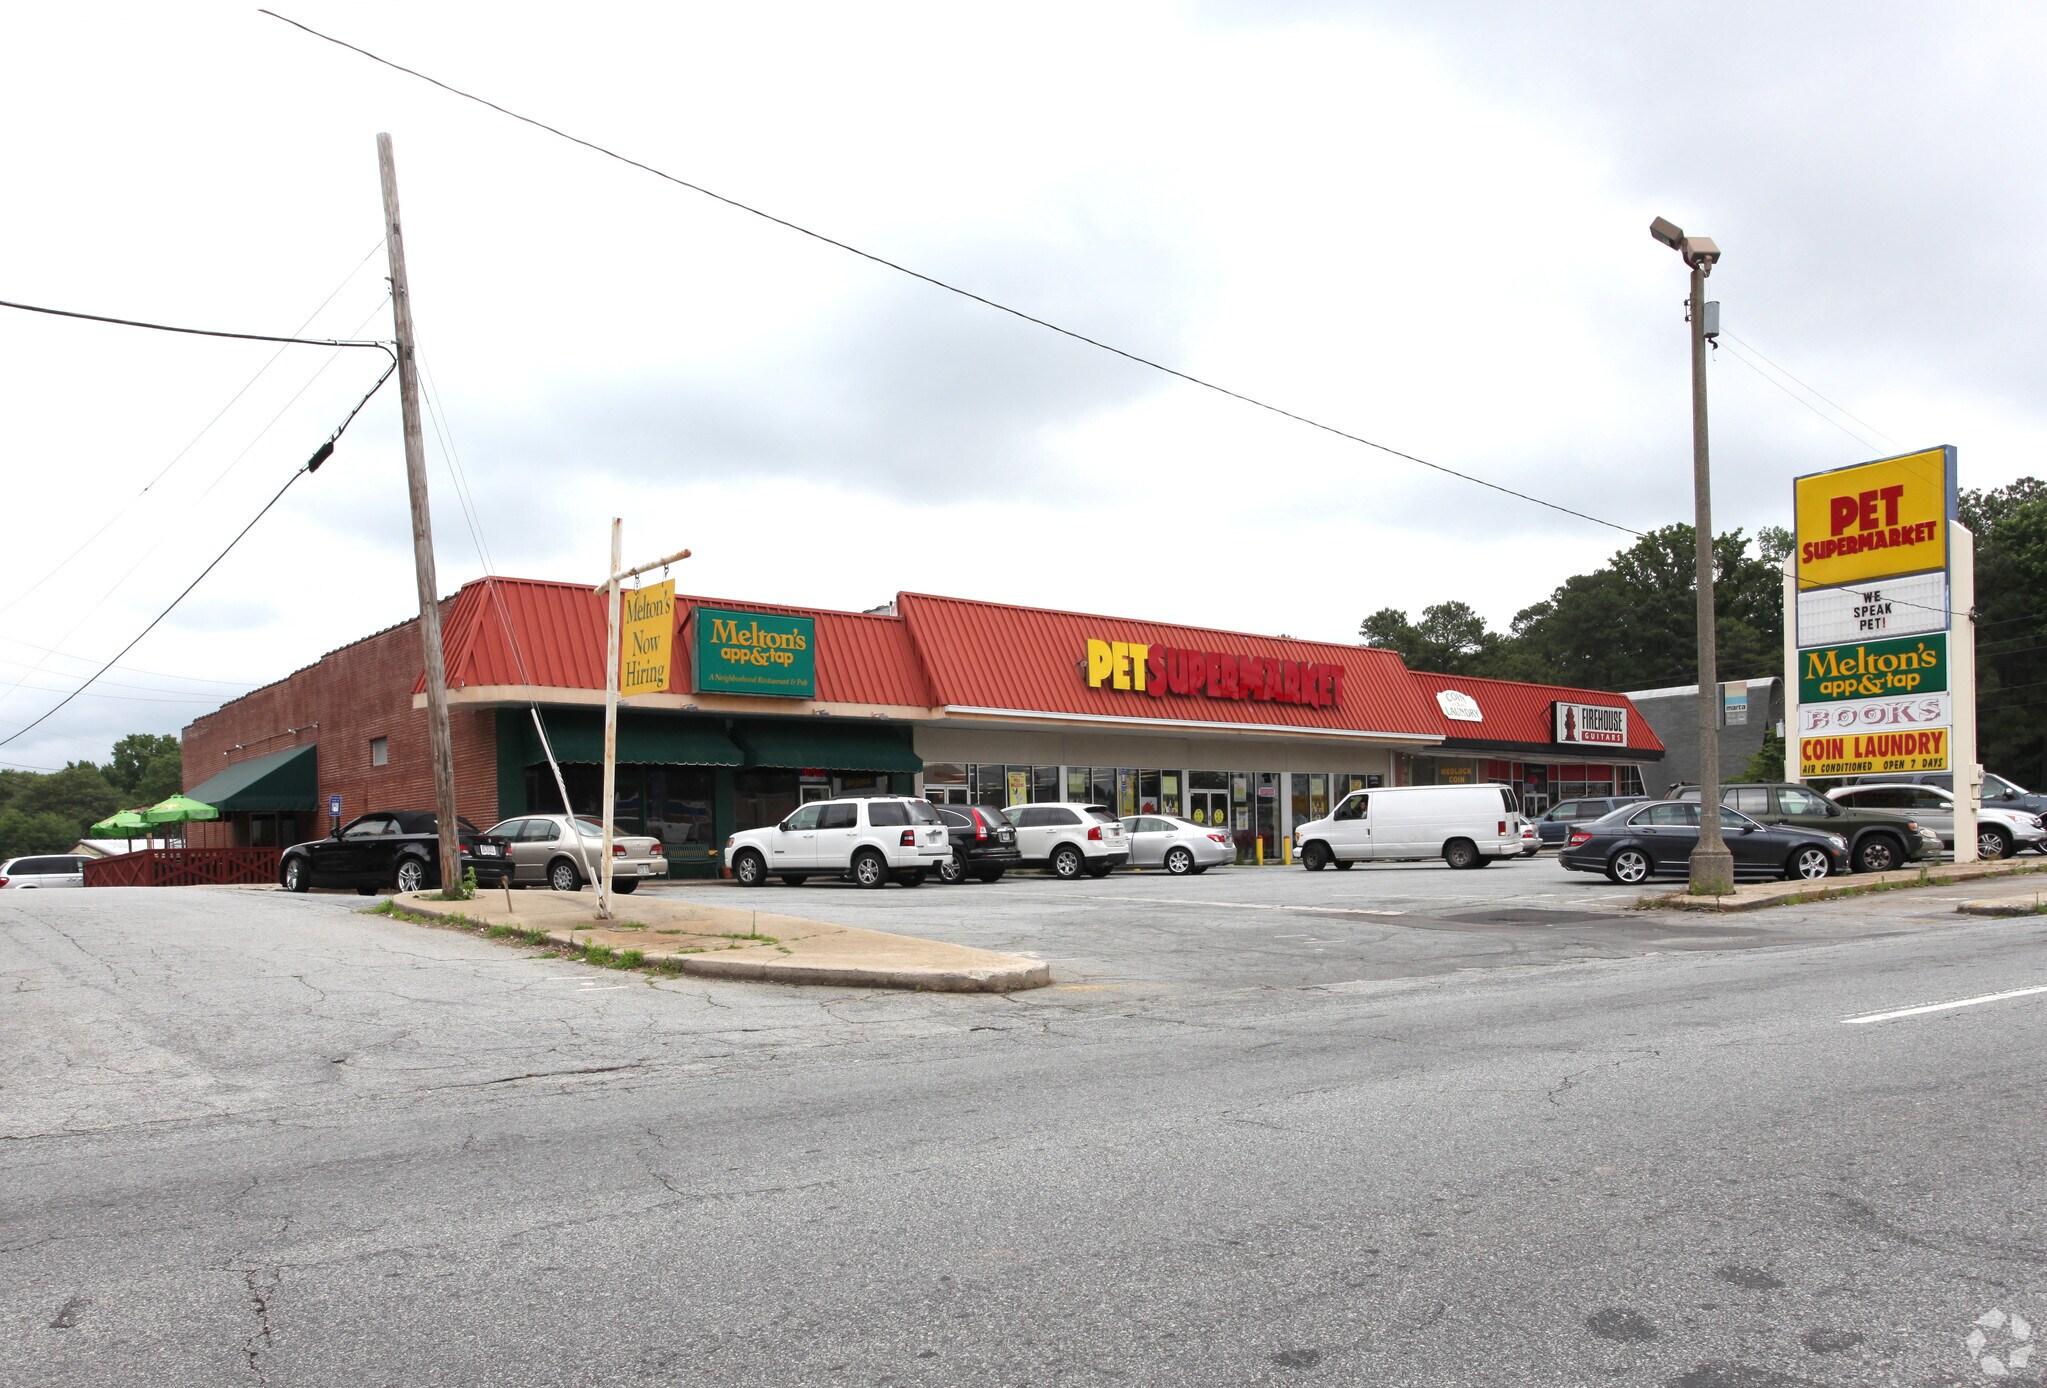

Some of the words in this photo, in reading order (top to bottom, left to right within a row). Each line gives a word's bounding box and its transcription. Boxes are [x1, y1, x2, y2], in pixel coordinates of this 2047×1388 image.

[1830, 484, 1904, 537] PET
[1802, 520, 1937, 565] SUPERMARKET
[626, 590, 671, 625] Melton's
[1853, 602, 1892, 618] SPEAK
[1863, 590, 1881, 604] WE
[709, 618, 807, 651] Melton's
[1859, 617, 1886, 631] PET!
[632, 629, 661, 657] Now
[625, 658, 665, 688] Hiring
[1086, 638, 1149, 692] PET
[1147, 643, 1346, 710] SUPERMARKET
[1804, 642, 1937, 680] Melton's
[1582, 707, 1623, 732] FIREHOUSE
[1804, 698, 1942, 731] BOOKS
[1584, 732, 1621, 742] GUITARS
[1802, 737, 1844, 761] COIN
[1854, 731, 1944, 759] LAUNDRY
[1448, 775, 1466, 784] COIN
[1802, 764, 1816, 775] AIR
[1820, 761, 1873, 774] CONDITIONED
[1883, 759, 1905, 770] OPEN
[1910, 759, 1917, 768] 7
[1922, 757, 1943, 768] DAYS
